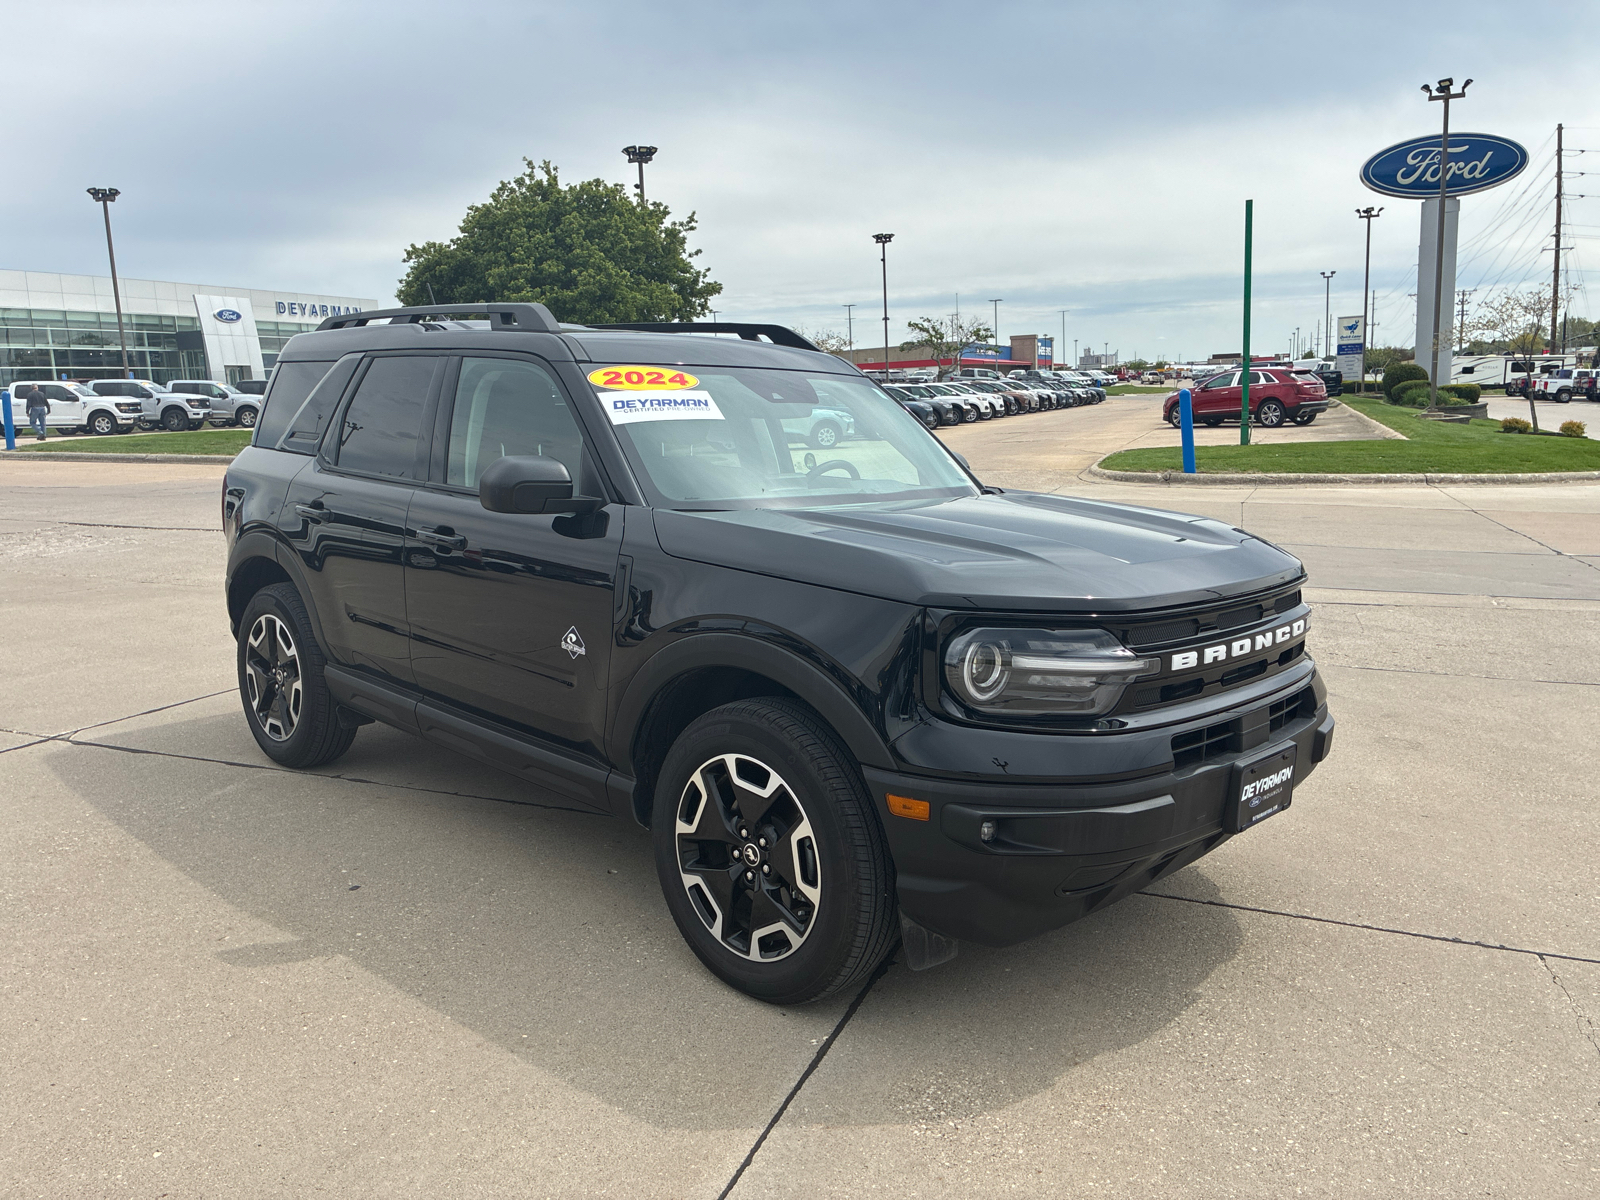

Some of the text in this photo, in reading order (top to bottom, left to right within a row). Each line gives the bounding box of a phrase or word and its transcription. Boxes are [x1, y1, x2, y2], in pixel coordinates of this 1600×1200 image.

[1397, 145, 1494, 185] Ford
[221, 310, 238, 320] Ford
[602, 371, 689, 386] 2024
[613, 398, 709, 410] DEYARMAN
[1171, 619, 1305, 671] BRONCO
[1241, 765, 1293, 801] DEYARMAN
